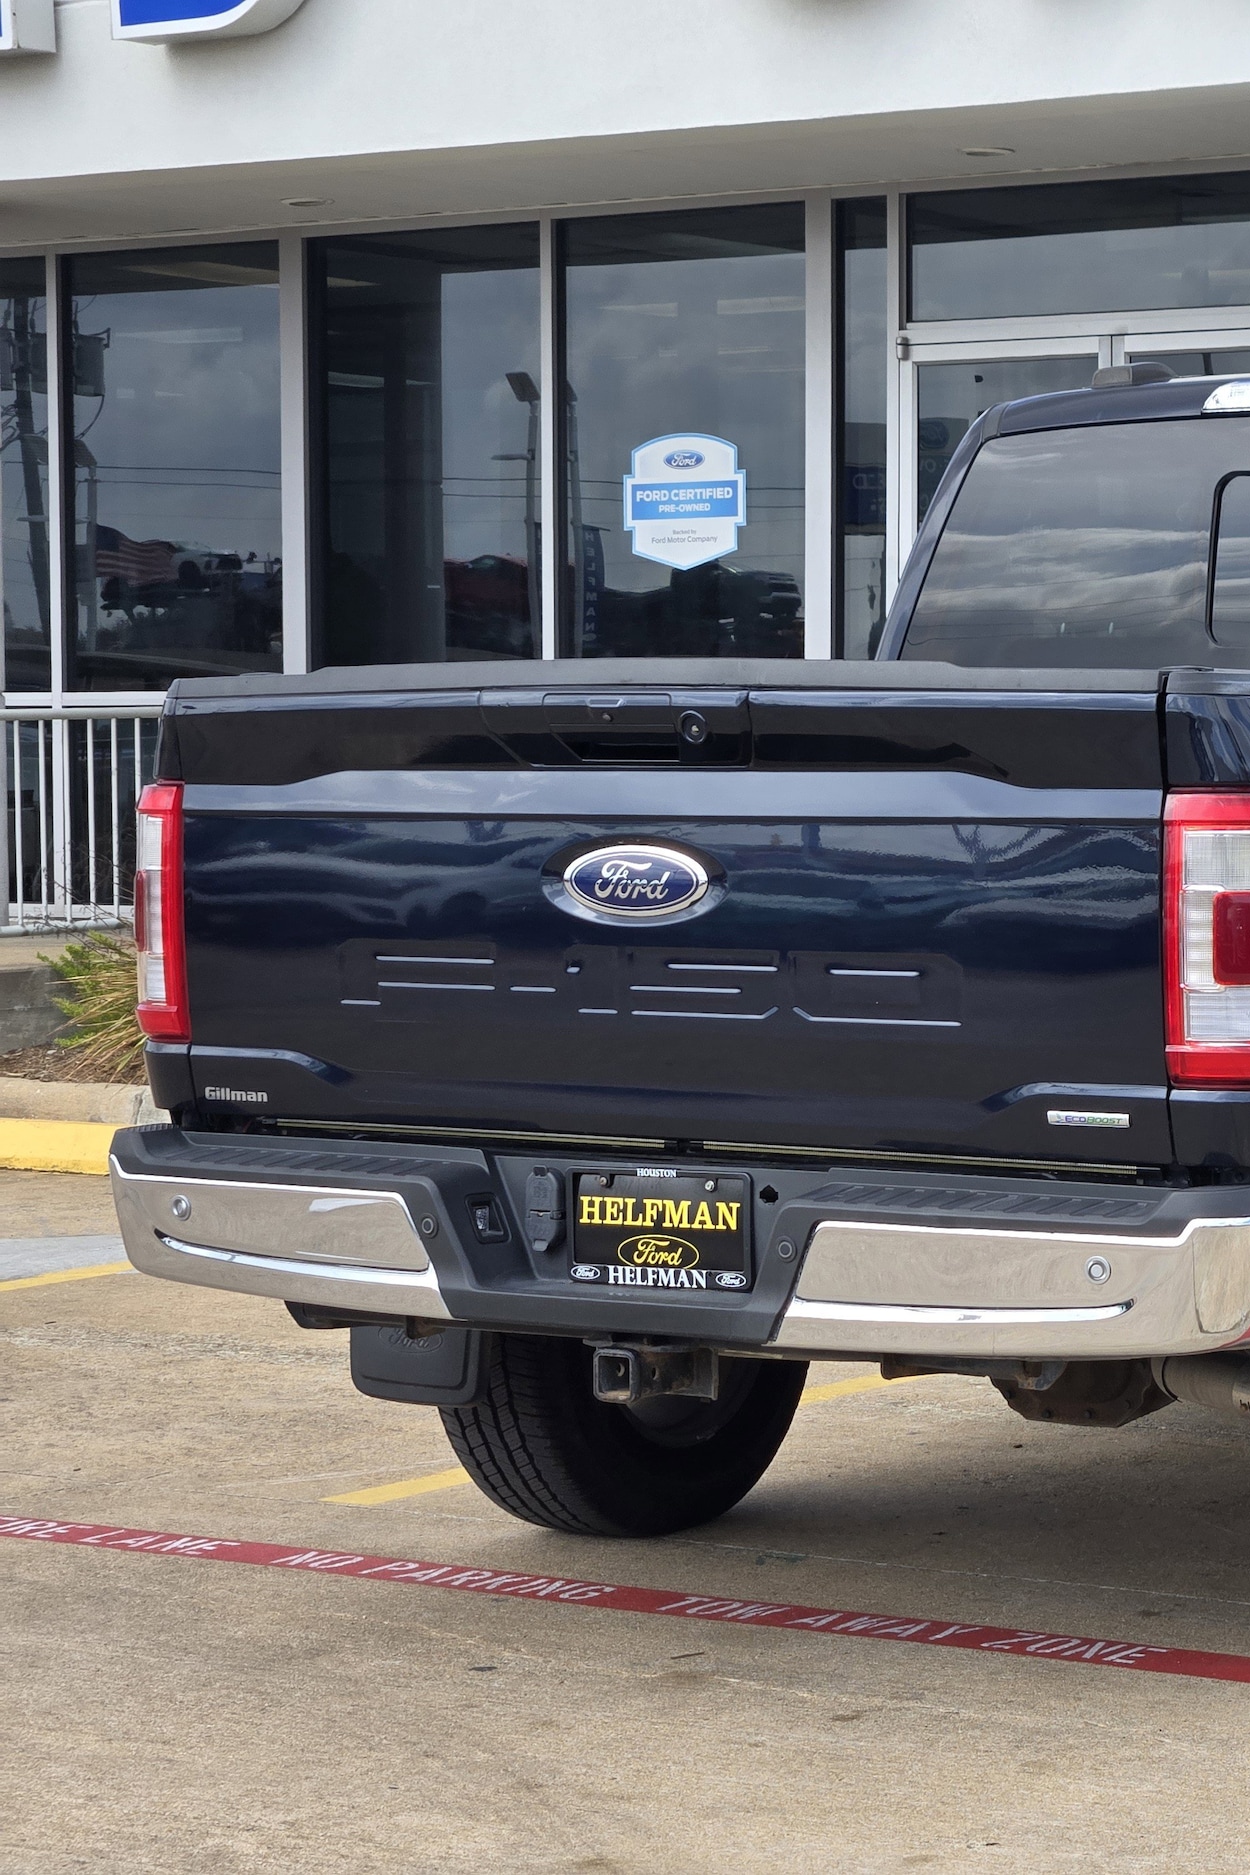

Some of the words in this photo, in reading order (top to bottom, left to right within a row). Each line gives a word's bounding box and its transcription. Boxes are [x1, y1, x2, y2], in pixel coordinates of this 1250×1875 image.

[671, 452, 697, 467] Ford
[636, 490, 669, 502] FORD
[670, 487, 733, 501] CERTIFIED
[658, 503, 711, 513] PRE-OWNED
[687, 535, 718, 543] Company
[594, 859, 671, 899] Ford
[204, 1086, 268, 1102] Gillman
[1065, 1115, 1124, 1125] ECOBOOST
[636, 1168, 677, 1178] HOUSTON
[579, 1196, 741, 1231] HELFMAN
[633, 1238, 683, 1267] Ford
[576, 1268, 596, 1279] Ford
[607, 1265, 708, 1289] HELFMAN
[720, 1275, 742, 1286] Ford
[78, 1529, 241, 1555] LANE
[270, 1551, 364, 1569] NO
[360, 1560, 616, 1602] PARKING
[656, 1596, 786, 1621] TOW
[786, 1612, 979, 1641] AWAY
[981, 1630, 1169, 1665] ZONE
